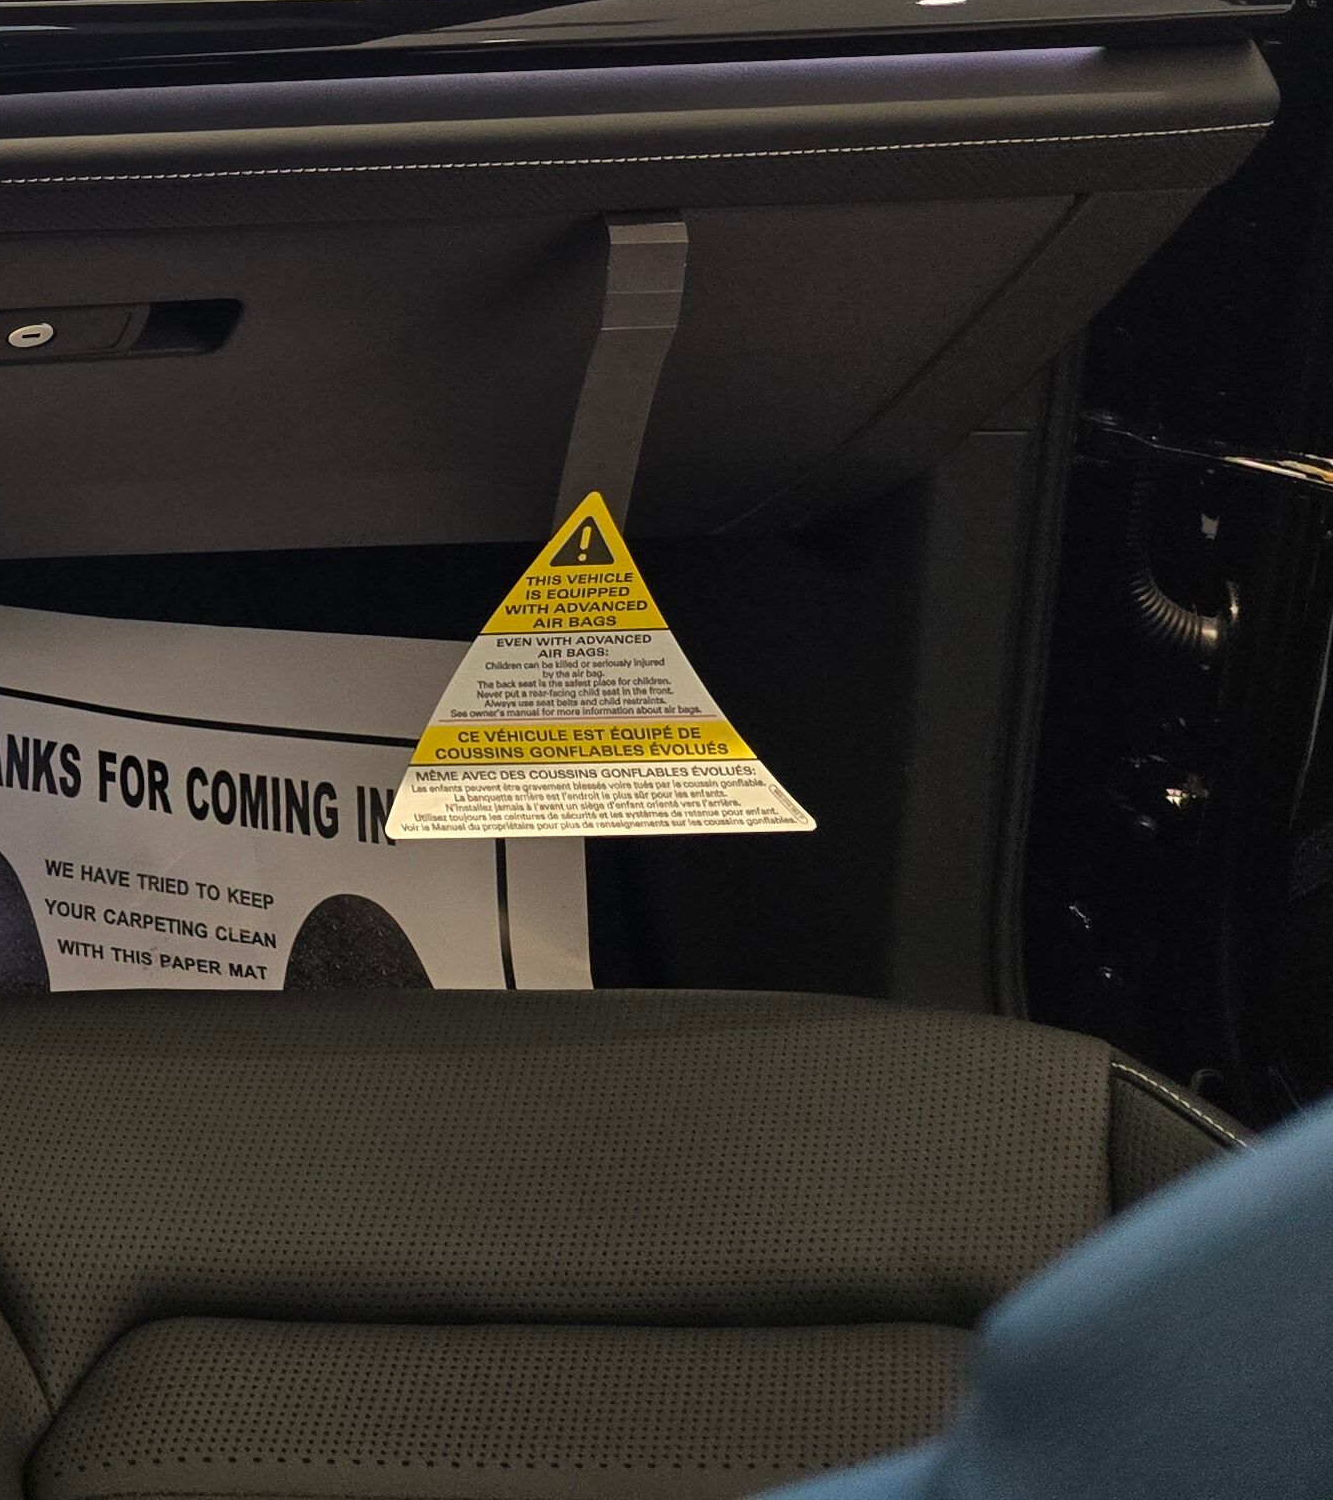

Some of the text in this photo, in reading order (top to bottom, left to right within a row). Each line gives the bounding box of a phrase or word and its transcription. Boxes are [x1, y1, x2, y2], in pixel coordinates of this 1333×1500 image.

[526, 572, 634, 587] THIS VEHICLE
[525, 586, 630, 601] IS EQUIPPED
[505, 600, 648, 615] WITH ADVANCED
[533, 615, 617, 629] AIR BAGS
[496, 634, 652, 648] EVEN WITH ADVANCED
[537, 648, 609, 659] AIR BAGS:
[485, 661, 522, 670] Children
[524, 662, 539, 670] can
[542, 661, 553, 669] be
[555, 659, 578, 669] killed
[592, 659, 632, 670] seriously
[634, 658, 665, 669] injured
[542, 669, 605, 680] by the air bag.
[458, 726, 701, 743] CE VÉHICULE EST ÉQUIPÉ DE
[435, 742, 729, 760] COUSSINS GONFLABLES ÉVOLUÉS
[416, 765, 756, 782] MÊME AVEC DES COUSSINS GONFLABLES ÉVOLUÉS:
[98, 749, 172, 814] FOR
[186, 766, 339, 840] COMING
[45, 859, 274, 910] WE HAVE TRIED TO KEEP
[44, 898, 277, 948] YOUR CARPETING CLEAN
[57, 939, 267, 980] WITH THIS PAPER MAT
